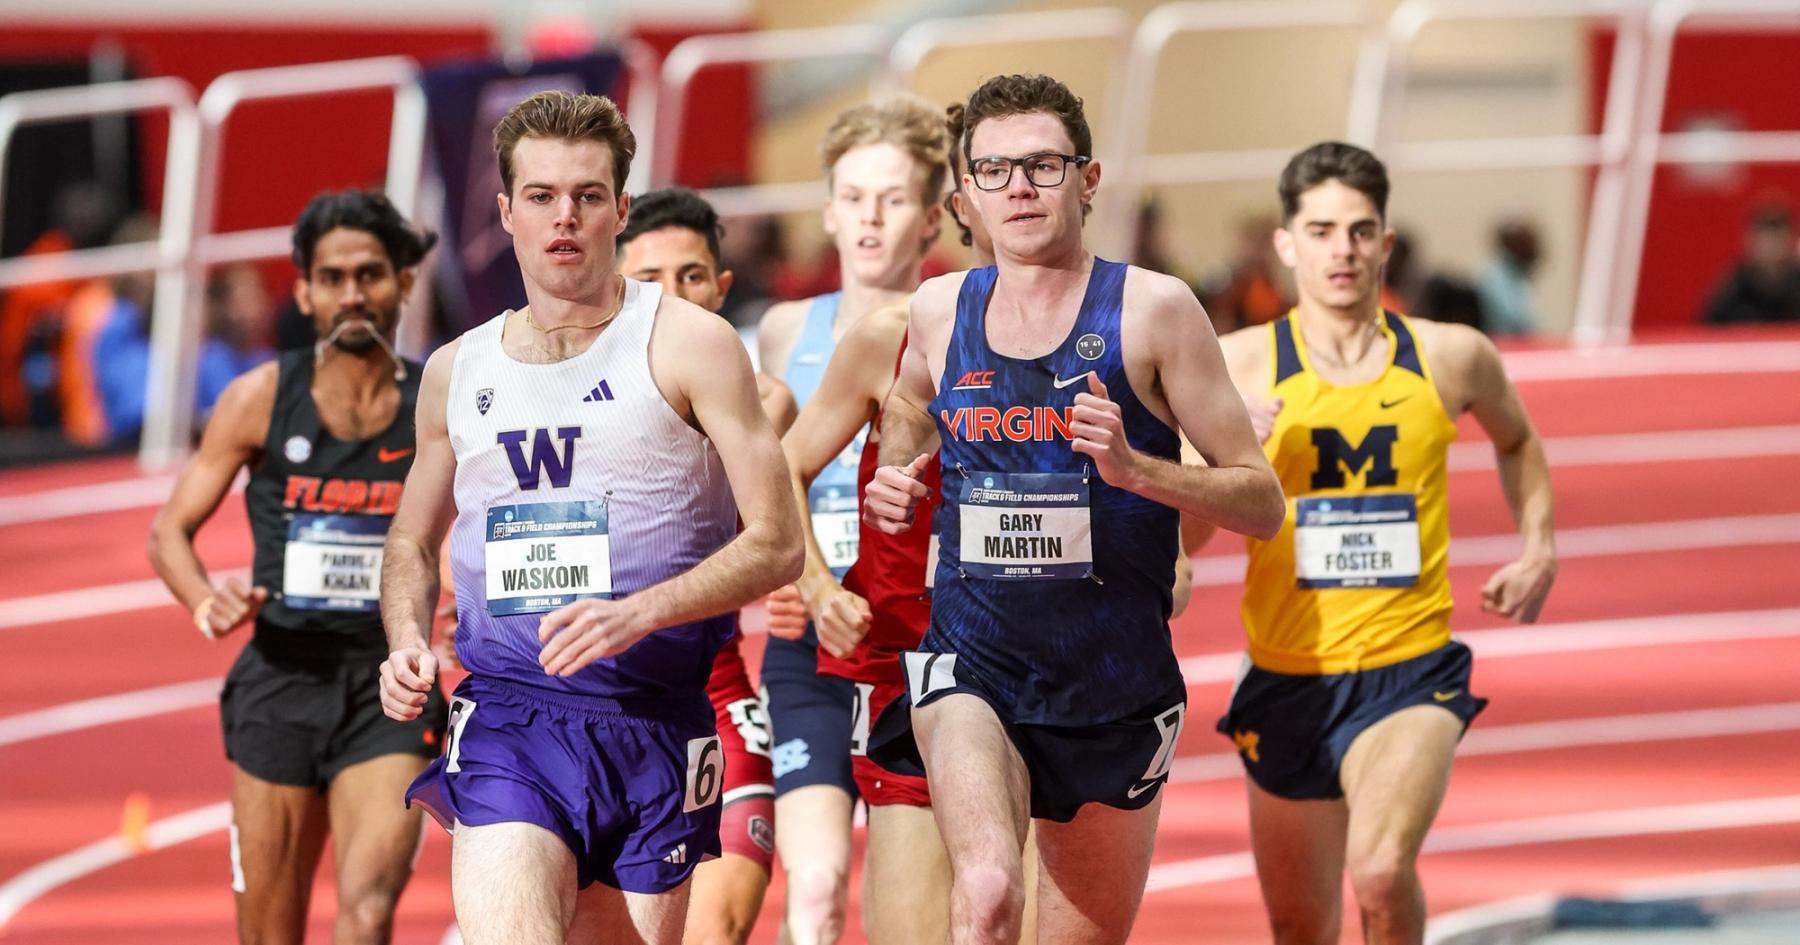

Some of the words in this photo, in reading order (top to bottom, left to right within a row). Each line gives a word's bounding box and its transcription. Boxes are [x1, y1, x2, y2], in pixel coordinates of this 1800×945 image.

[955, 371, 996, 386] ACC
[941, 406, 1075, 442] VIRGIN
[496, 426, 582, 491] W
[1311, 425, 1398, 489] M
[982, 492, 1000, 501] TRACK
[1004, 493, 1022, 501] FIELD
[1023, 493, 1079, 502] CHAMPIONSHIPS
[504, 523, 521, 534] TRACK
[526, 522, 543, 532] FIELD
[543, 521, 597, 531] CHAMPIONSHIPS
[1000, 514, 1043, 531] GARY
[984, 536, 1062, 558] MARTIN
[1341, 532, 1376, 546] NICK
[526, 543, 556, 562] JOE
[1326, 551, 1393, 571] FOSTER
[502, 565, 589, 592] WASKOM
[695, 739, 718, 806] 6
